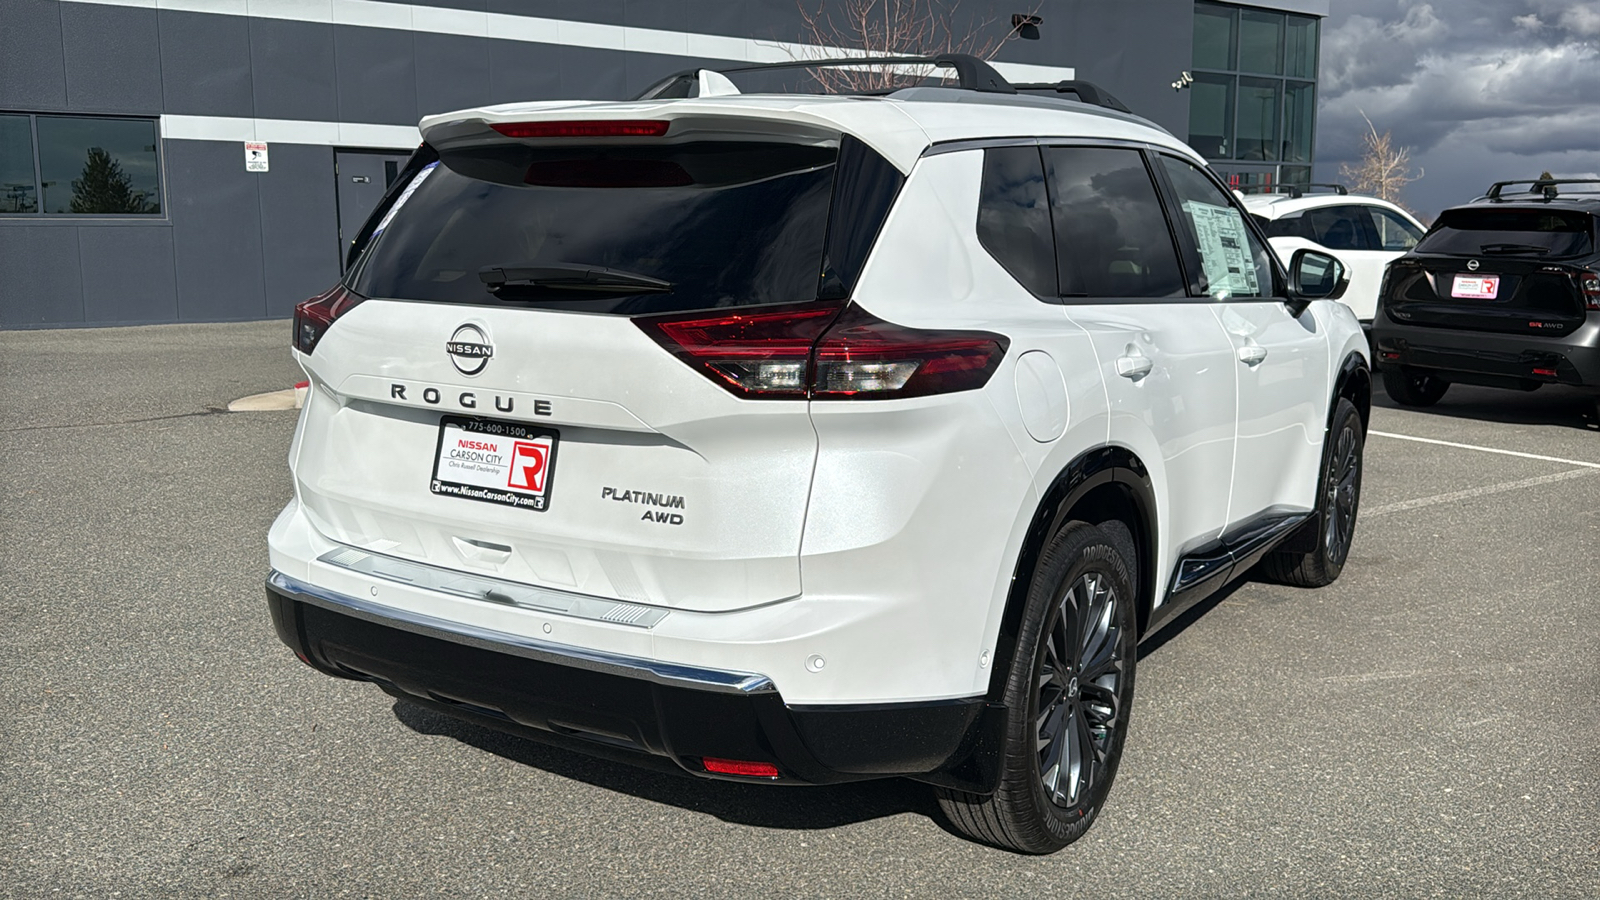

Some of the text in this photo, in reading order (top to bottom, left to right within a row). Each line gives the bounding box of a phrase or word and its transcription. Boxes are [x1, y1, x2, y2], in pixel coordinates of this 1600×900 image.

[446, 343, 491, 356] NISSAN
[391, 383, 553, 416] ROGUE
[468, 421, 526, 437] 775-600-1500
[458, 439, 497, 452] NISSAN
[450, 448, 503, 465] CARSON CITY
[448, 460, 500, 475] Chris Russell Dealership
[517, 445, 544, 490] R
[441, 485, 534, 506] www.NissanCarsonCity.com
[601, 486, 686, 510] PLATINUM
[640, 510, 684, 526] AWD
[1082, 543, 1129, 586] BRIDGESTONE
